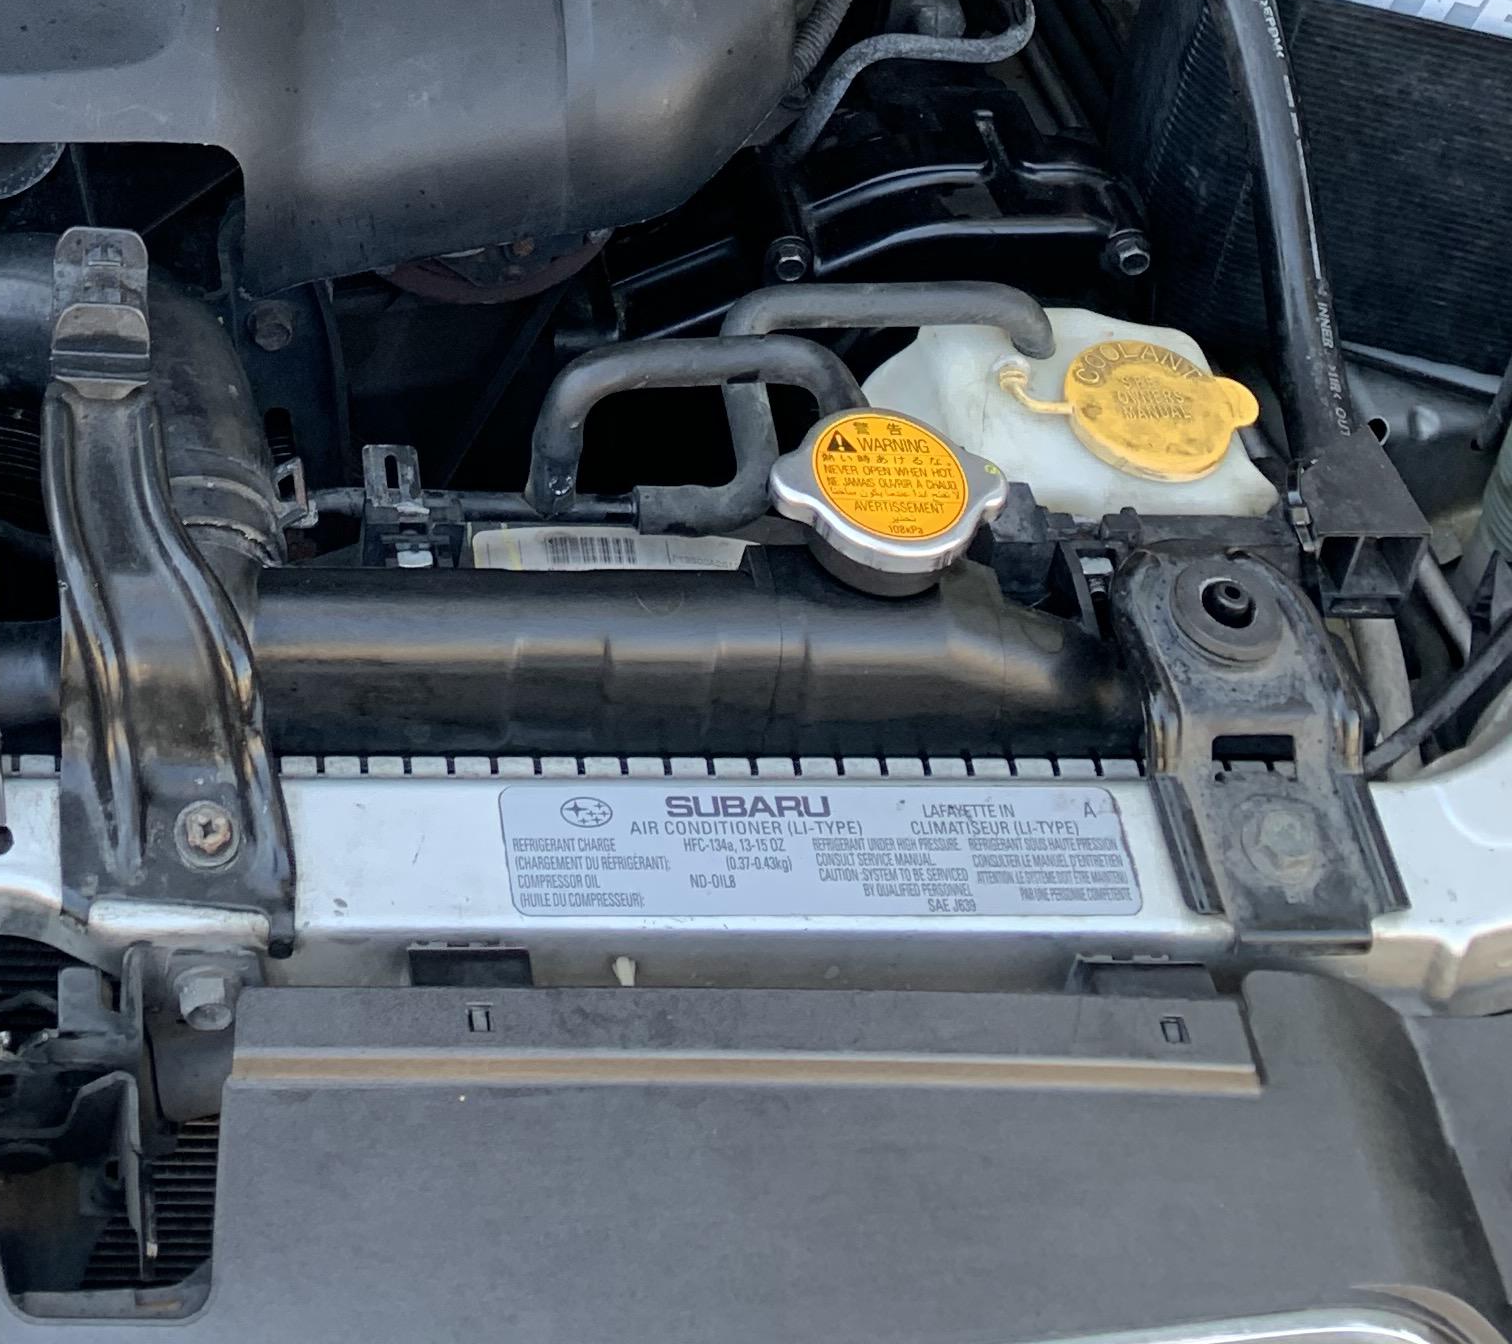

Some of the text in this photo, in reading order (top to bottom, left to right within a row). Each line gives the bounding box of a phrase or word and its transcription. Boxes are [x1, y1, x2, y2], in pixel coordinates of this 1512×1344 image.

[1317, 301, 1334, 349] INNER
[1075, 343, 1203, 384] COOLANT
[1121, 405, 1192, 420] MANUAL
[856, 437, 930, 454] WARNING
[823, 463, 858, 476] NEVER
[862, 465, 891, 477] OPEN
[897, 467, 927, 478] WHEN
[854, 499, 945, 514] AVERTISSEMENT
[664, 795, 832, 818] SUBARU
[922, 803, 1016, 819] LAFAYETTE IN
[1083, 801, 1097, 818] A
[630, 820, 863, 837] AIR CONDITIONER (LI-TYPE)
[910, 820, 1080, 837] CLIMATISEUR (LI-TYPE)
[512, 838, 616, 852] REFRIGERANT CHARGE
[739, 838, 768, 852] 13-15
[812, 837, 866, 852] REFRIGERANT
[866, 837, 895, 852] UNDER
[897, 837, 917, 852] HIGH
[1025, 838, 1048, 852] SOUS
[1048, 838, 1076, 852] HAUTE
[515, 856, 585, 871] (CHARGEMENT
[586, 856, 599, 871] DU
[726, 856, 792, 873] (0.37-0.43kg)
[815, 853, 855, 867] CONSULT
[857, 853, 894, 867] SERVICE
[1021, 854, 1032, 868] LE
[517, 874, 601, 889] COMPRESSOR OIL
[690, 874, 736, 889] ND-OIL8
[818, 868, 859, 882] CAUTION
[899, 868, 912, 882] TO
[912, 868, 926, 882] BE
[927, 868, 969, 882] SERVICED
[862, 883, 973, 897] BY QUALIFIED PERSONNEL
[520, 893, 551, 908] (HUILE
[553, 893, 566, 908] DU
[927, 898, 977, 913] SAE J639
